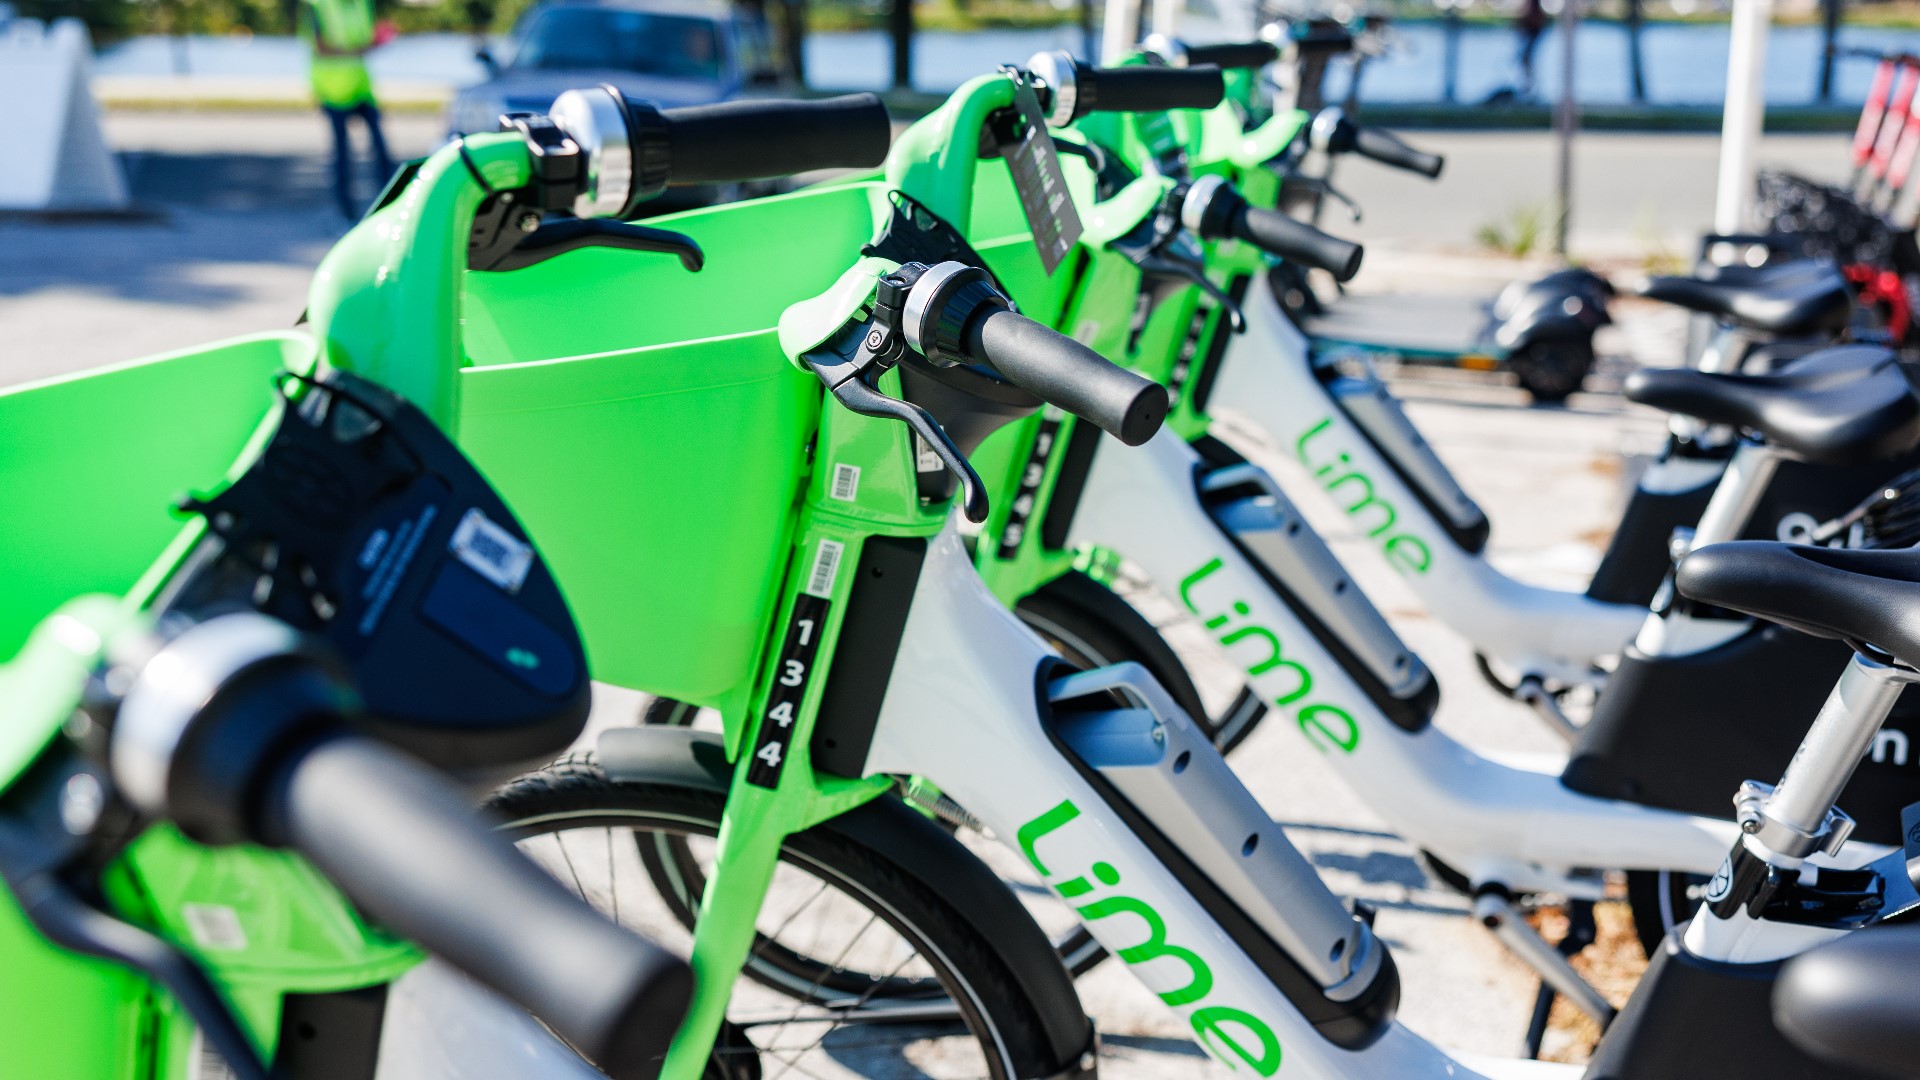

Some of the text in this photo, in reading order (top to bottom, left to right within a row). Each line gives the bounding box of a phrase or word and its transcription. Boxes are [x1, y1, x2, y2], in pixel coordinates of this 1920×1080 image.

[1297, 416, 1434, 575] Lime
[757, 619, 815, 768] 1344
[1179, 556, 1361, 753] Lime
[1017, 799, 1282, 1078] Lime
